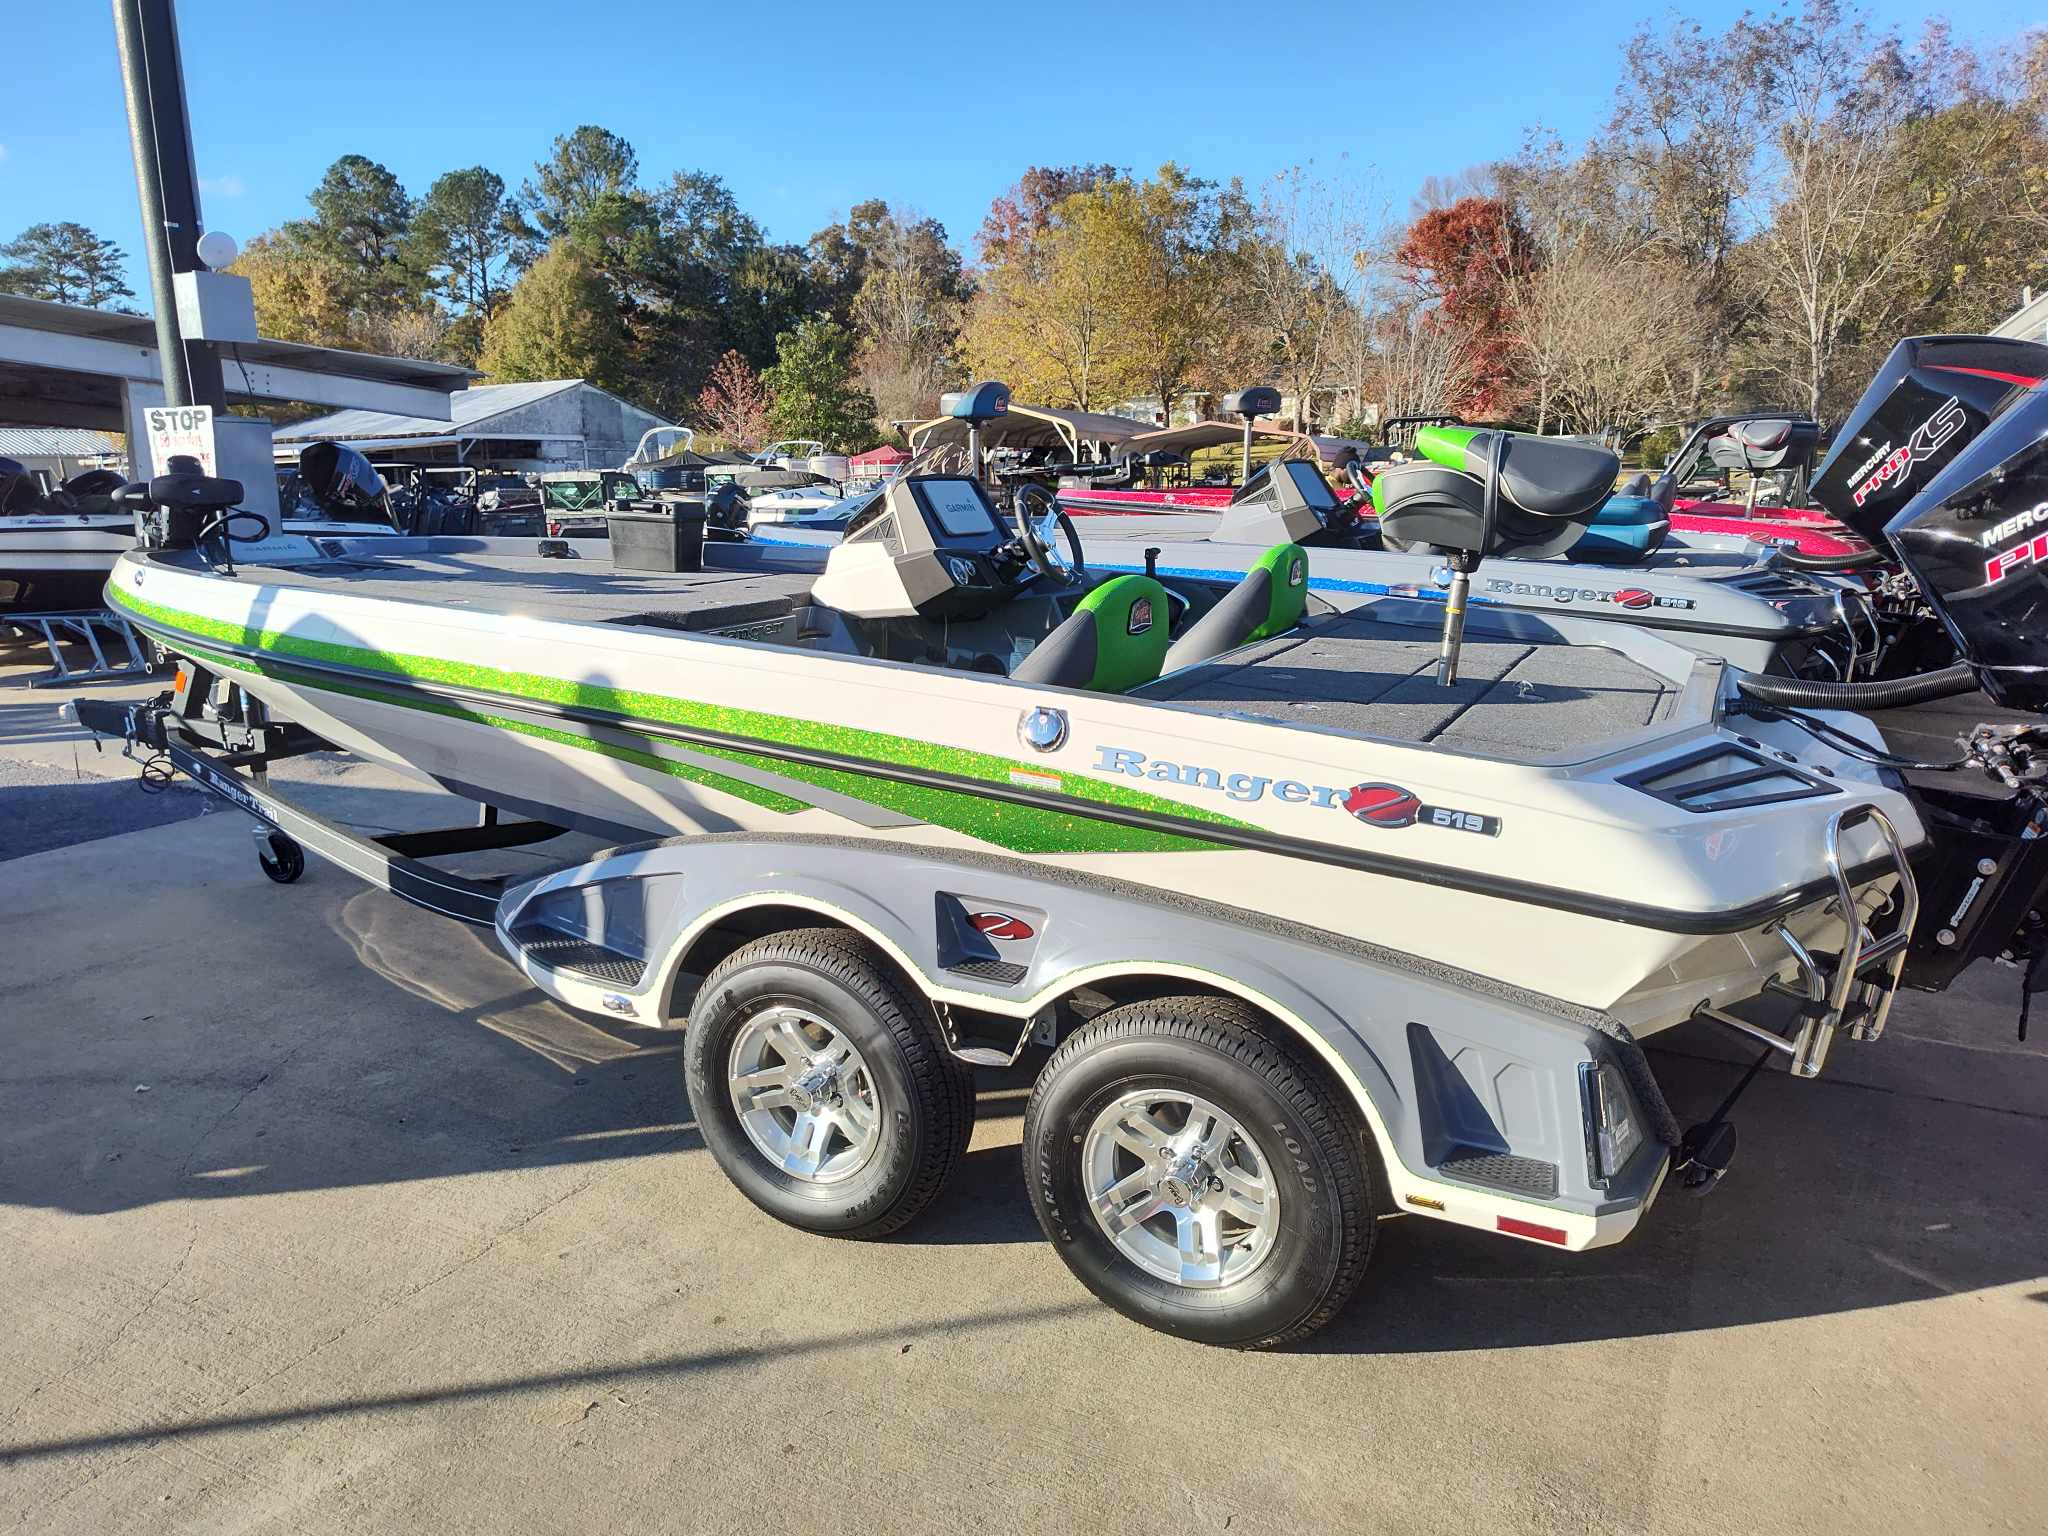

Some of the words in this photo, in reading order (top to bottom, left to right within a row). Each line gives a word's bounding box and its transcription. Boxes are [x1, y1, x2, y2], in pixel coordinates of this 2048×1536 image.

[150, 409, 207, 432] STOP
[1847, 440, 1892, 489] MERCURY
[944, 503, 977, 513] GARMIN
[1485, 578, 1618, 604] Ranger
[1092, 744, 1352, 809] Ranger
[1433, 808, 1484, 832] 519
[1271, 1121, 1318, 1193] LOAD
